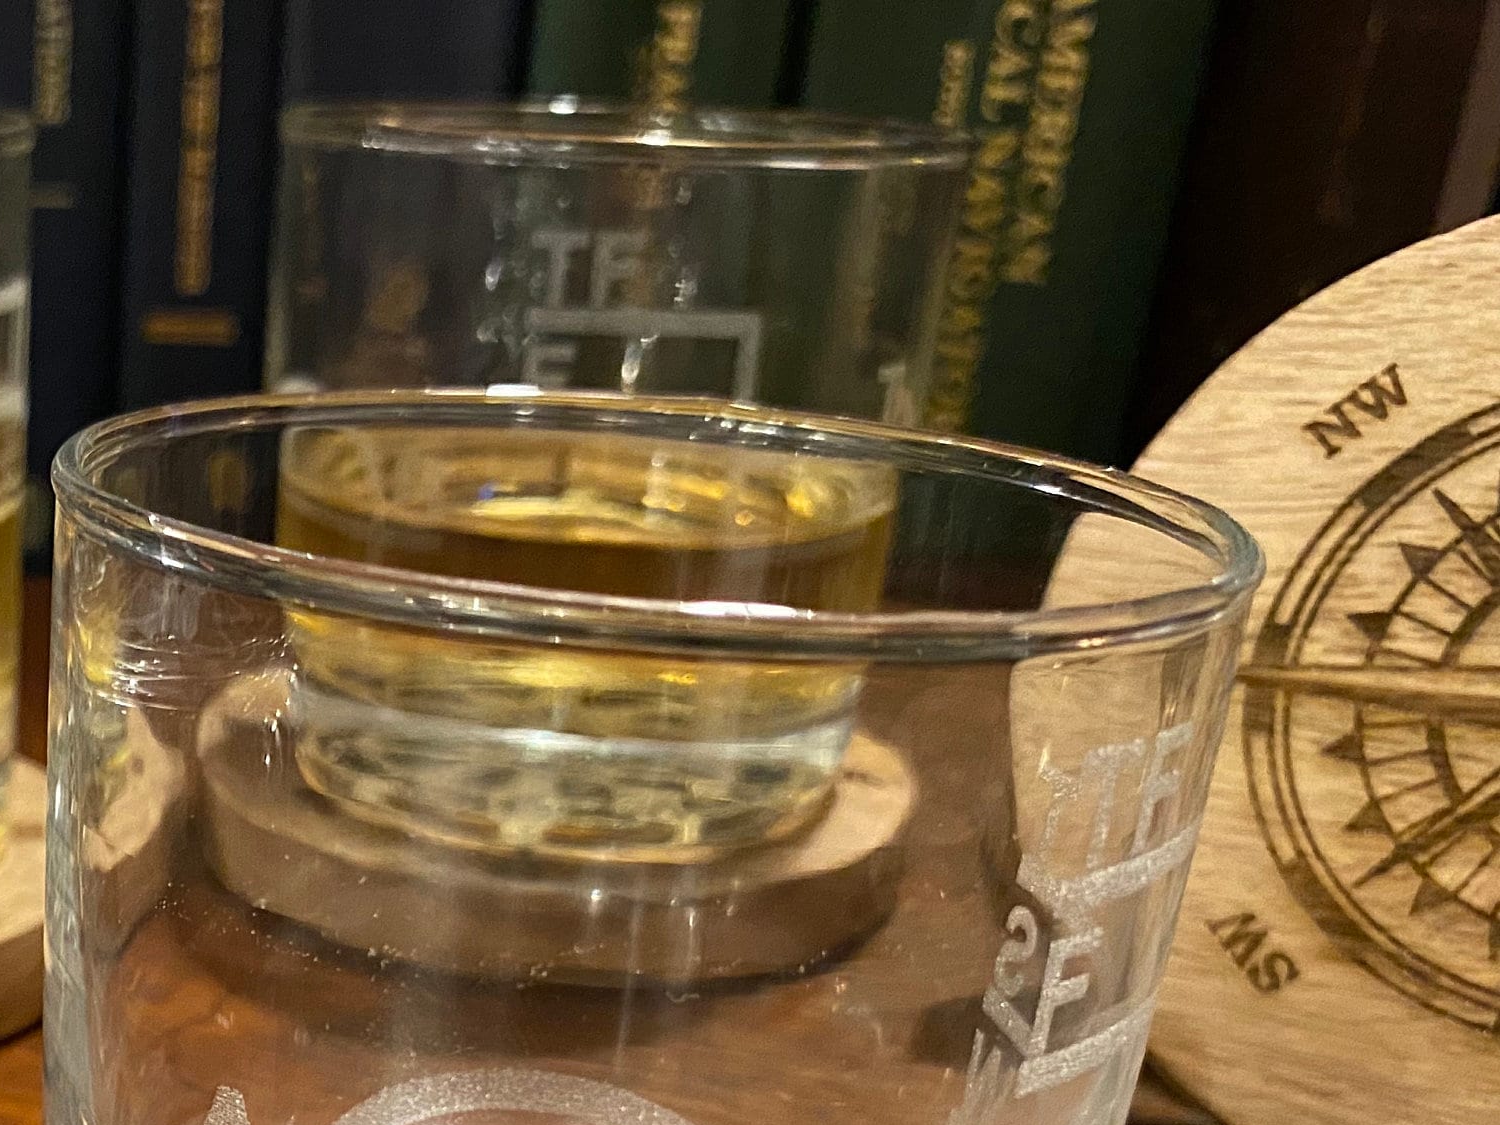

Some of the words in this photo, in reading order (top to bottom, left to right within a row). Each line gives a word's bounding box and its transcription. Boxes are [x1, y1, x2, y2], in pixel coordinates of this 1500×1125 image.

[531, 229, 648, 305] TF
[1303, 363, 1411, 460] NW
[1205, 911, 1300, 995] SW
